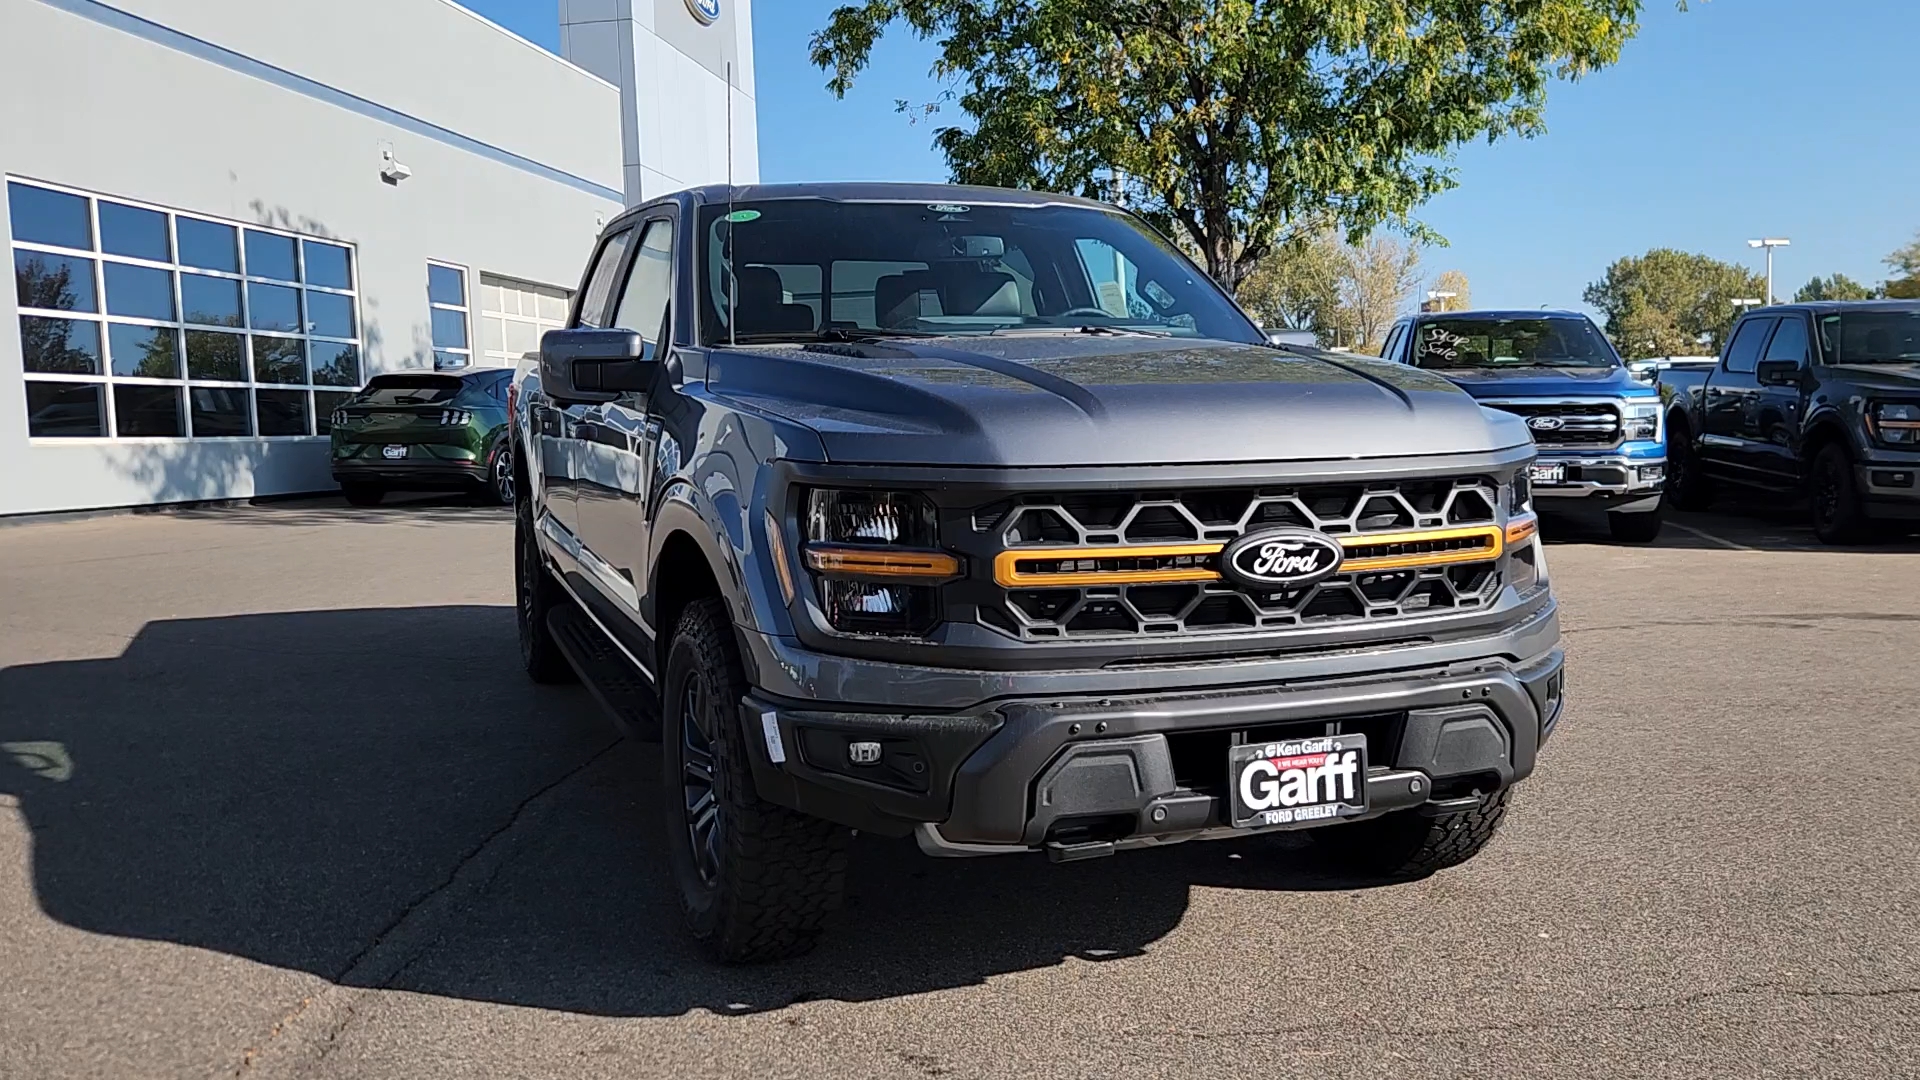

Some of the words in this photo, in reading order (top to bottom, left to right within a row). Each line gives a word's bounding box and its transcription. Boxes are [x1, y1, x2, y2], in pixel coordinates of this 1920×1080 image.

[1420, 341, 1458, 360] Sale
[1534, 416, 1555, 427] Ford
[382, 447, 408, 456] Garff
[1530, 466, 1564, 480] Garff
[1253, 543, 1320, 574] Ford
[1276, 743, 1301, 756] Ken
[1302, 739, 1332, 752] Garff
[1240, 751, 1357, 810] Garff
[1266, 809, 1293, 824] FORD
[1294, 805, 1338, 819] GREELEY
